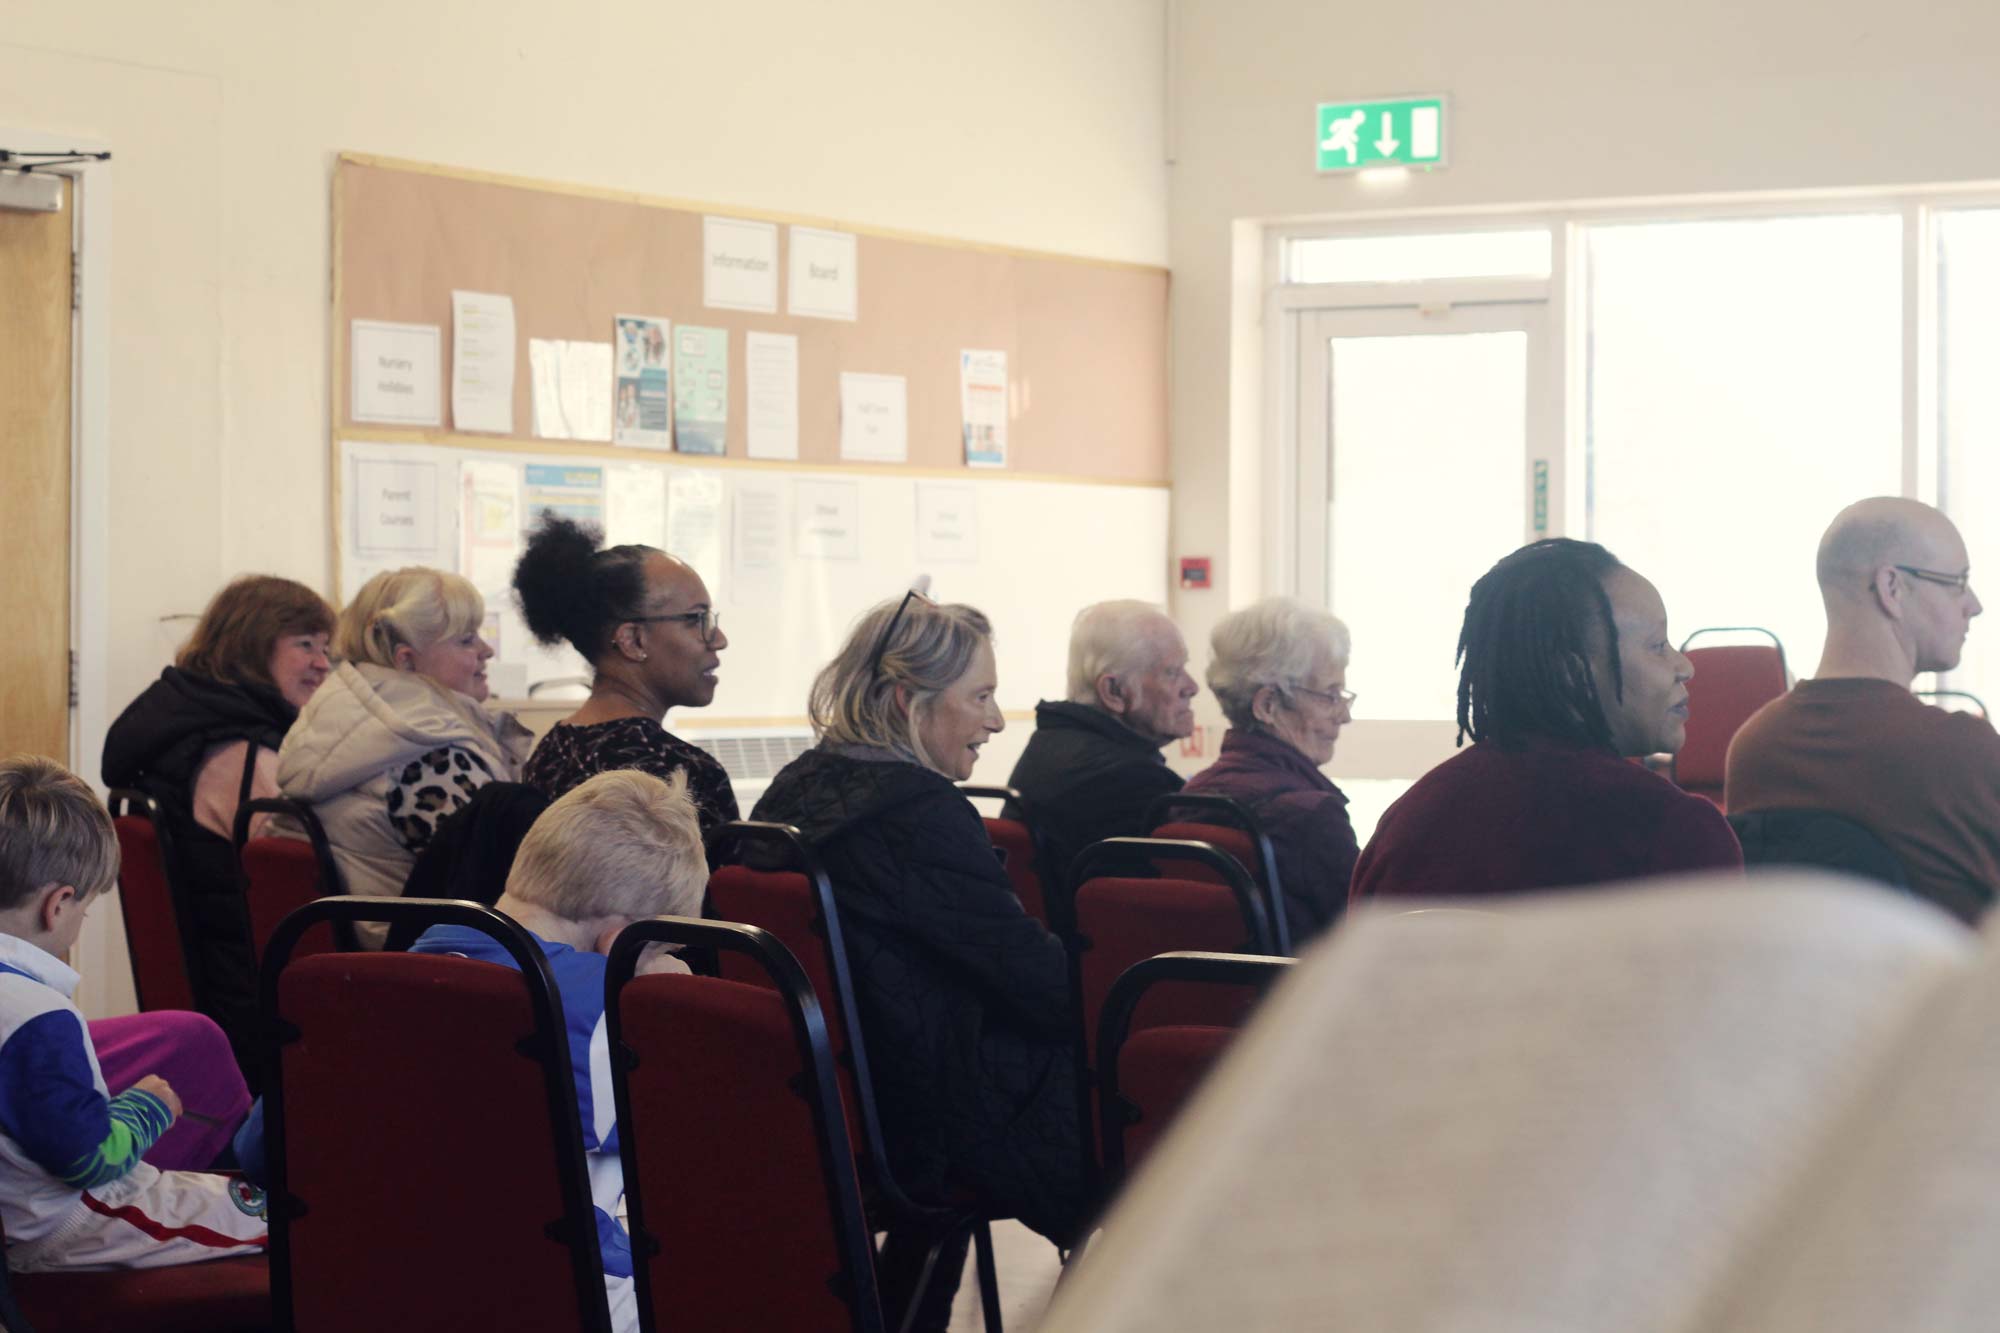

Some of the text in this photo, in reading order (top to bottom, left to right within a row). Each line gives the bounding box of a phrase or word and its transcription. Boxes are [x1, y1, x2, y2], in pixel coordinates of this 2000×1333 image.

[809, 262, 838, 281] Board
[382, 488, 411, 502] Parent
[380, 512, 414, 526] Courses
